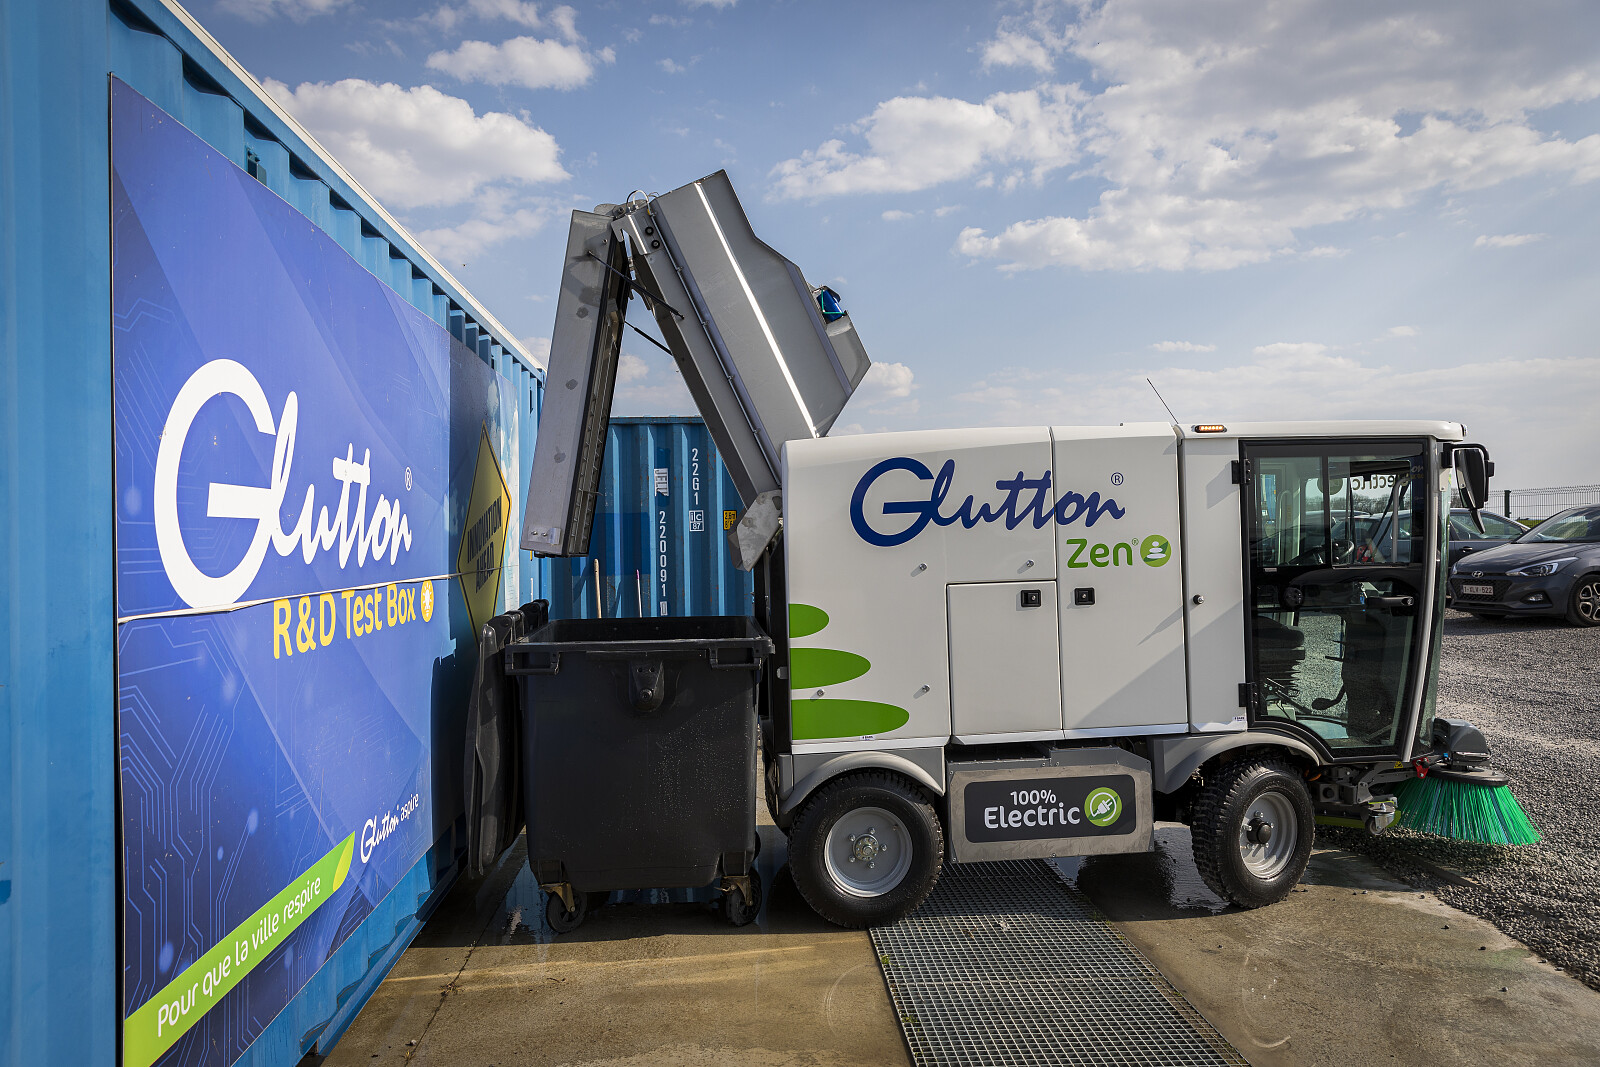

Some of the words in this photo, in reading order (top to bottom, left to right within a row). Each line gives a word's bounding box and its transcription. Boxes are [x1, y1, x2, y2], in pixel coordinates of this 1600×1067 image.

[154, 358, 413, 609] Glutton
[692, 448, 700, 506] 22G1
[849, 456, 1126, 547] Glutton
[467, 495, 502, 564] INNOVATION
[659, 511, 667, 597] 220091
[1066, 537, 1133, 568] Zen
[273, 593, 336, 659] R&D
[341, 587, 383, 640] Test
[387, 582, 416, 628] Box
[984, 802, 1081, 829] Electric
[1010, 789, 1057, 805] 100%
[361, 815, 400, 864] Glutton
[157, 981, 199, 1038] Pour
[202, 955, 231, 998] que
[235, 939, 249, 967] la
[251, 912, 280, 951] ville
[283, 877, 321, 925] respire
